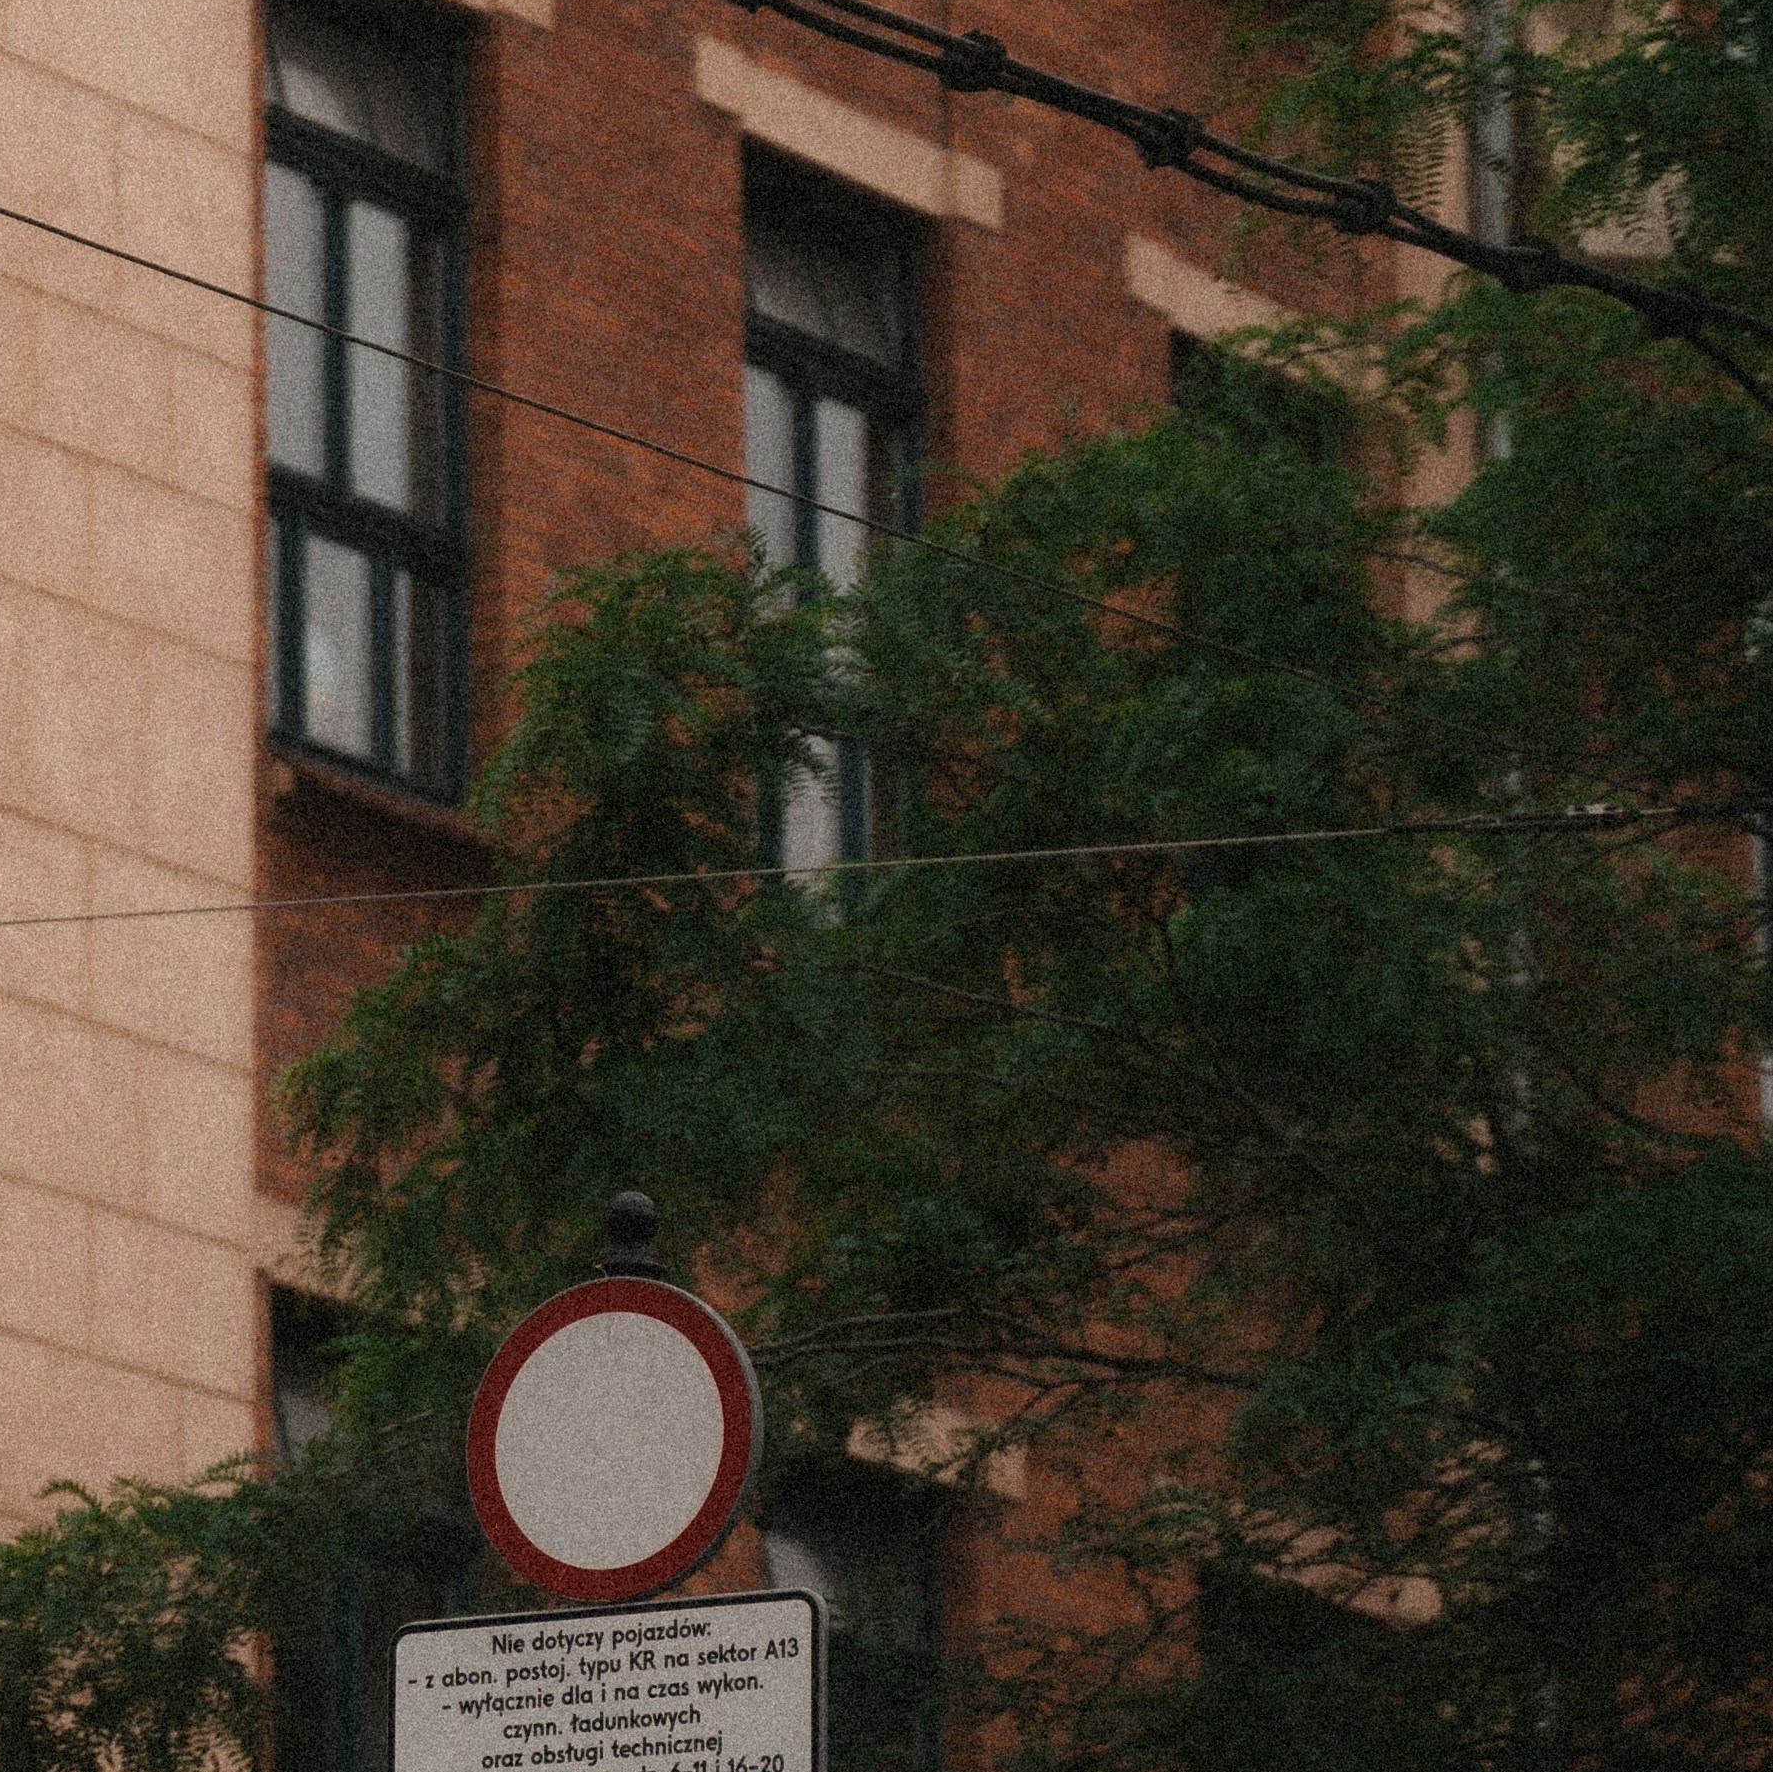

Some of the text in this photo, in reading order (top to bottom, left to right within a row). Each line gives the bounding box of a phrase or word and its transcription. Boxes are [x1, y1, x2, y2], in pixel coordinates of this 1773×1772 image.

[491, 1617, 712, 1655] Nie dotyczy pojazdów:
[425, 1674, 435, 1690] z
[441, 1666, 498, 1688] abon.
[505, 1656, 571, 1689] postoj.
[578, 1656, 622, 1682] typu
[629, 1649, 657, 1672] KR
[664, 1653, 690, 1669] na
[697, 1643, 758, 1666] sektor
[764, 1636, 799, 1660] A13
[458, 1687, 555, 1720] wyłącznie
[561, 1684, 594, 1706] dla
[601, 1682, 607, 1703] i
[613, 1685, 640, 1702] na
[647, 1681, 690, 1699] czas
[696, 1671, 764, 1700] wykon.
[502, 1703, 701, 1744] czynn. ładunkowych
[481, 1729, 723, 1770] oraz obsługi technicznej
